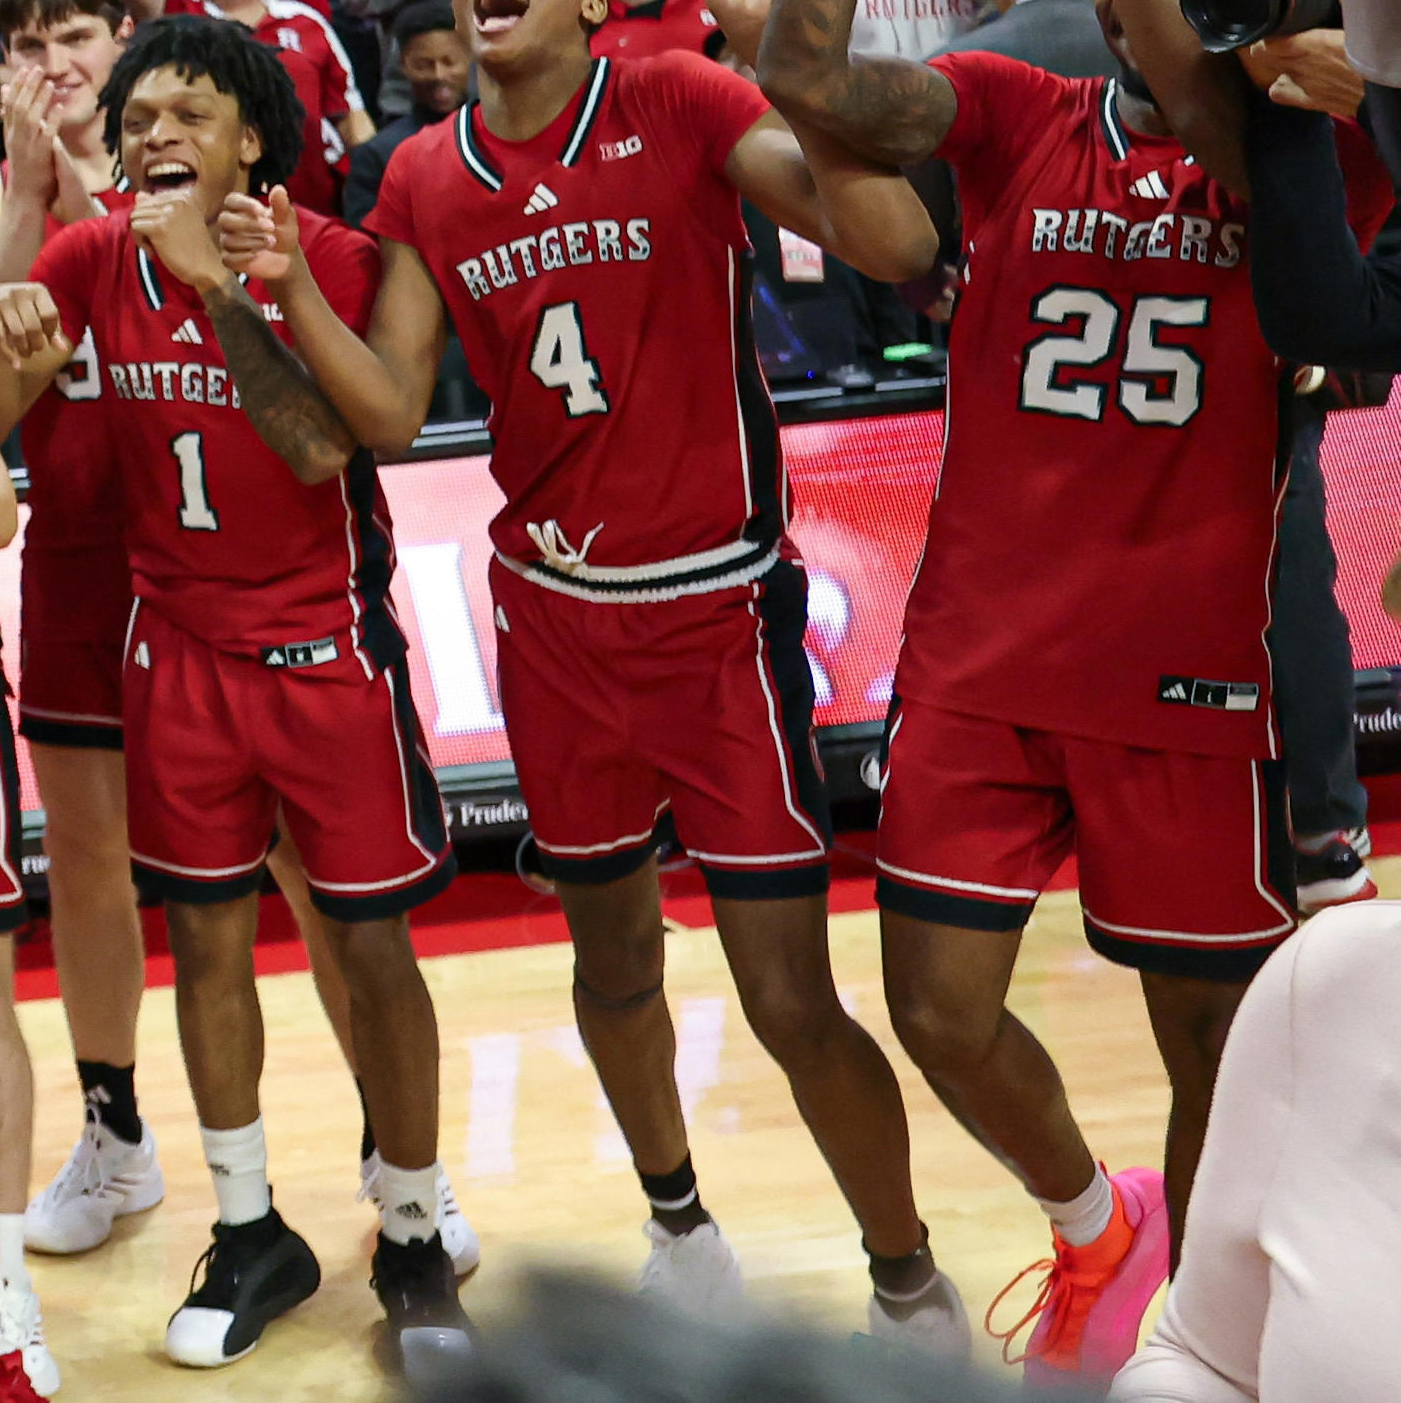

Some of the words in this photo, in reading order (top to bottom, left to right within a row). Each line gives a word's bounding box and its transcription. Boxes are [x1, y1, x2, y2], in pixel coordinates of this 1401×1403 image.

[456, 217, 652, 302] RUTGERS
[1031, 207, 1246, 270] RUTGERS
[107, 360, 243, 410] RUTGE
[530, 301, 609, 419] 4
[1018, 282, 1213, 429] 25
[171, 430, 220, 532] 1
[1353, 706, 1401, 734] rude
